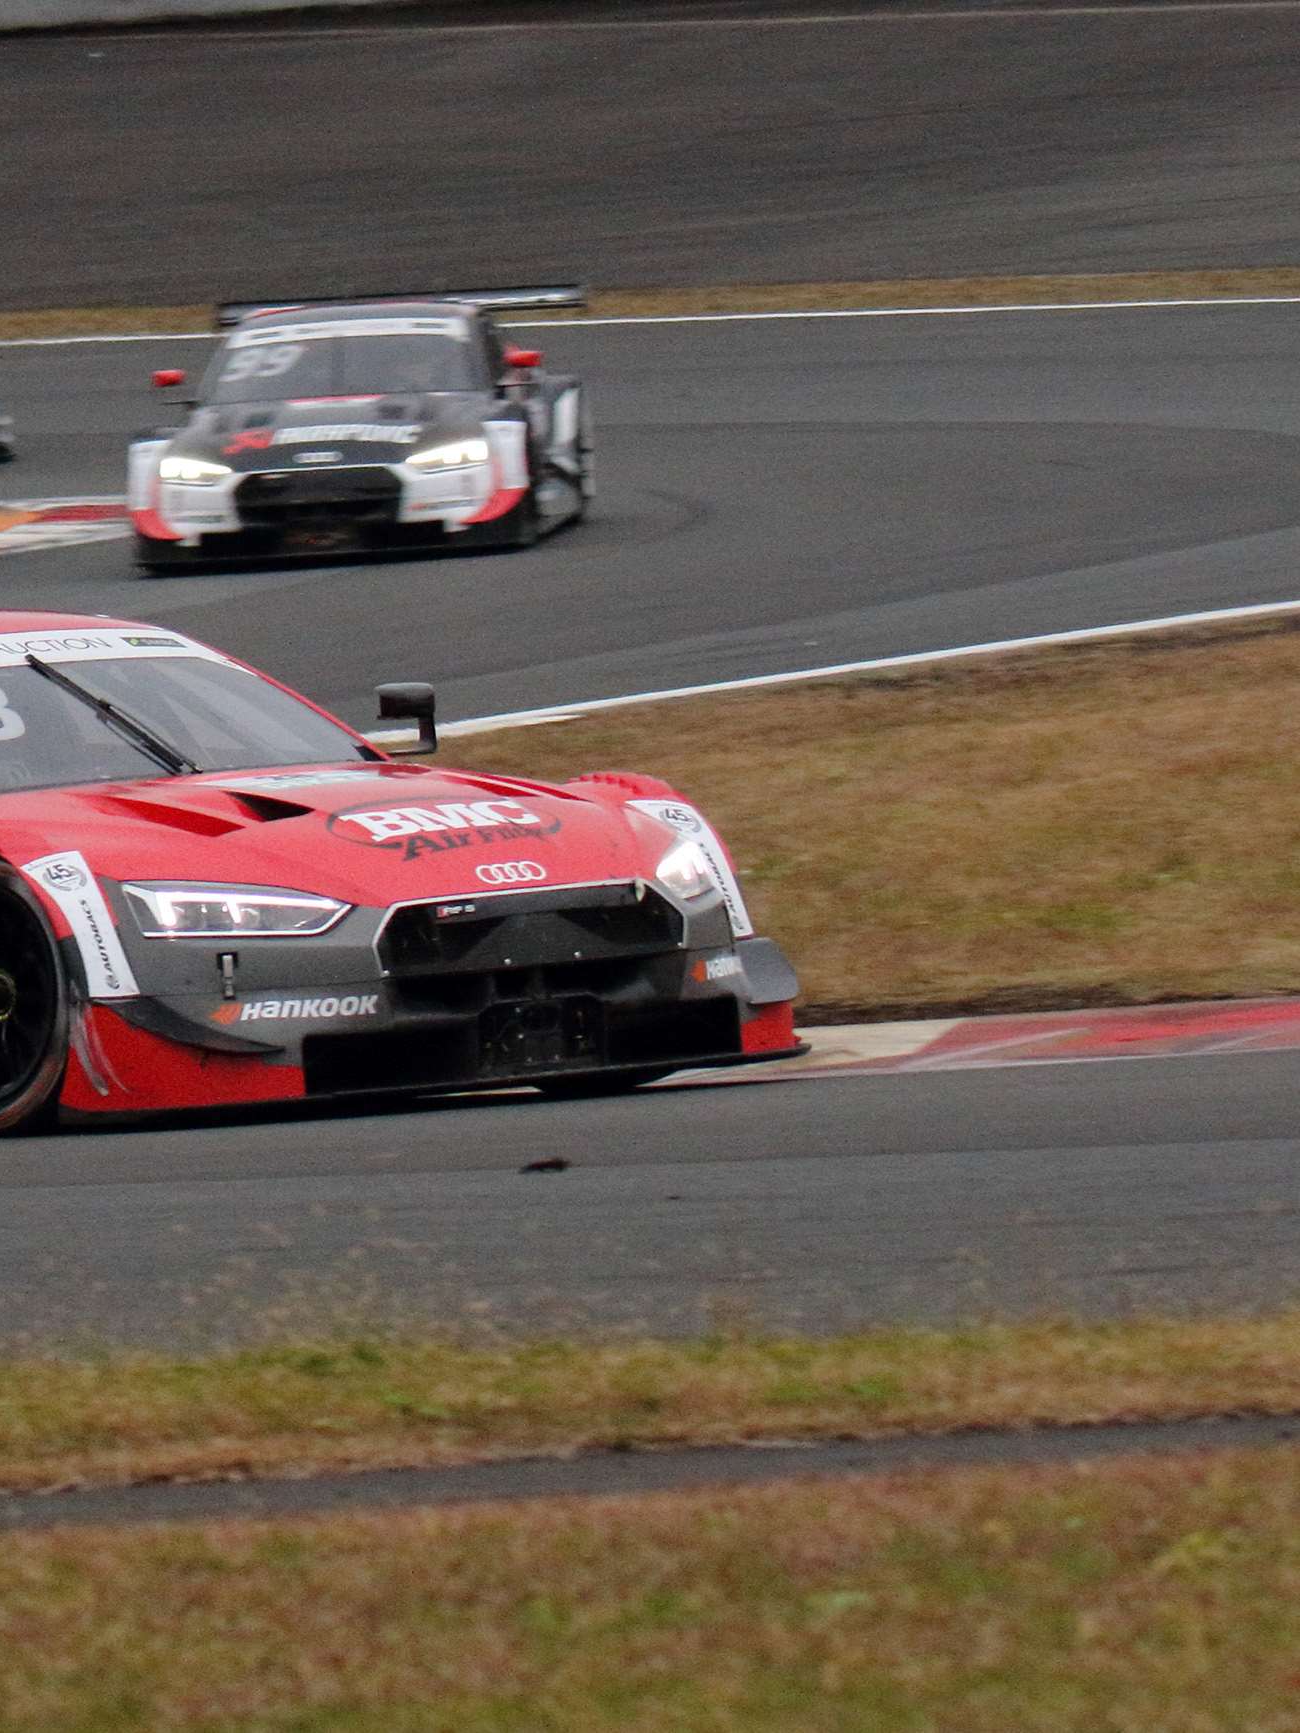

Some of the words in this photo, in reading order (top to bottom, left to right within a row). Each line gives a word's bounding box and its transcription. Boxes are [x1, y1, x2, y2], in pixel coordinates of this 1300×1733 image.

[337, 799, 542, 842] BMC
[402, 822, 472, 862] Air
[46, 863, 73, 881] 45
[79, 898, 113, 974] AUTOBACS
